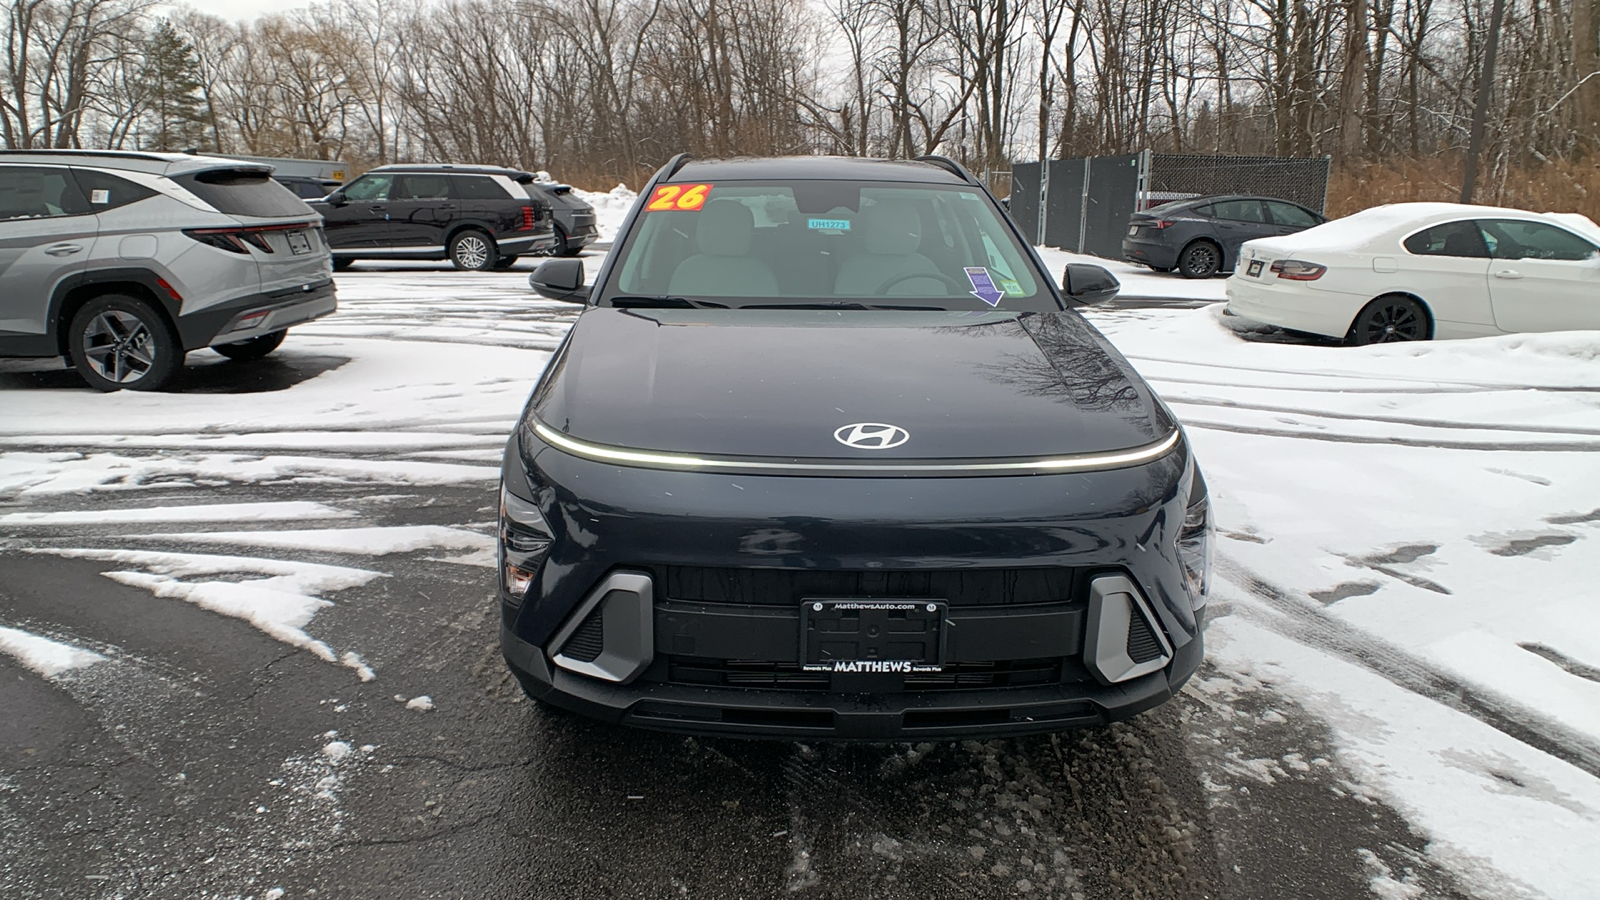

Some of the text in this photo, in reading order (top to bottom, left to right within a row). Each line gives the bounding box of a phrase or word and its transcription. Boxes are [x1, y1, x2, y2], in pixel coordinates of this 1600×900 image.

[648, 184, 708, 210] 26
[811, 220, 846, 229] UH1273
[834, 661, 912, 672] MATTHEWS
